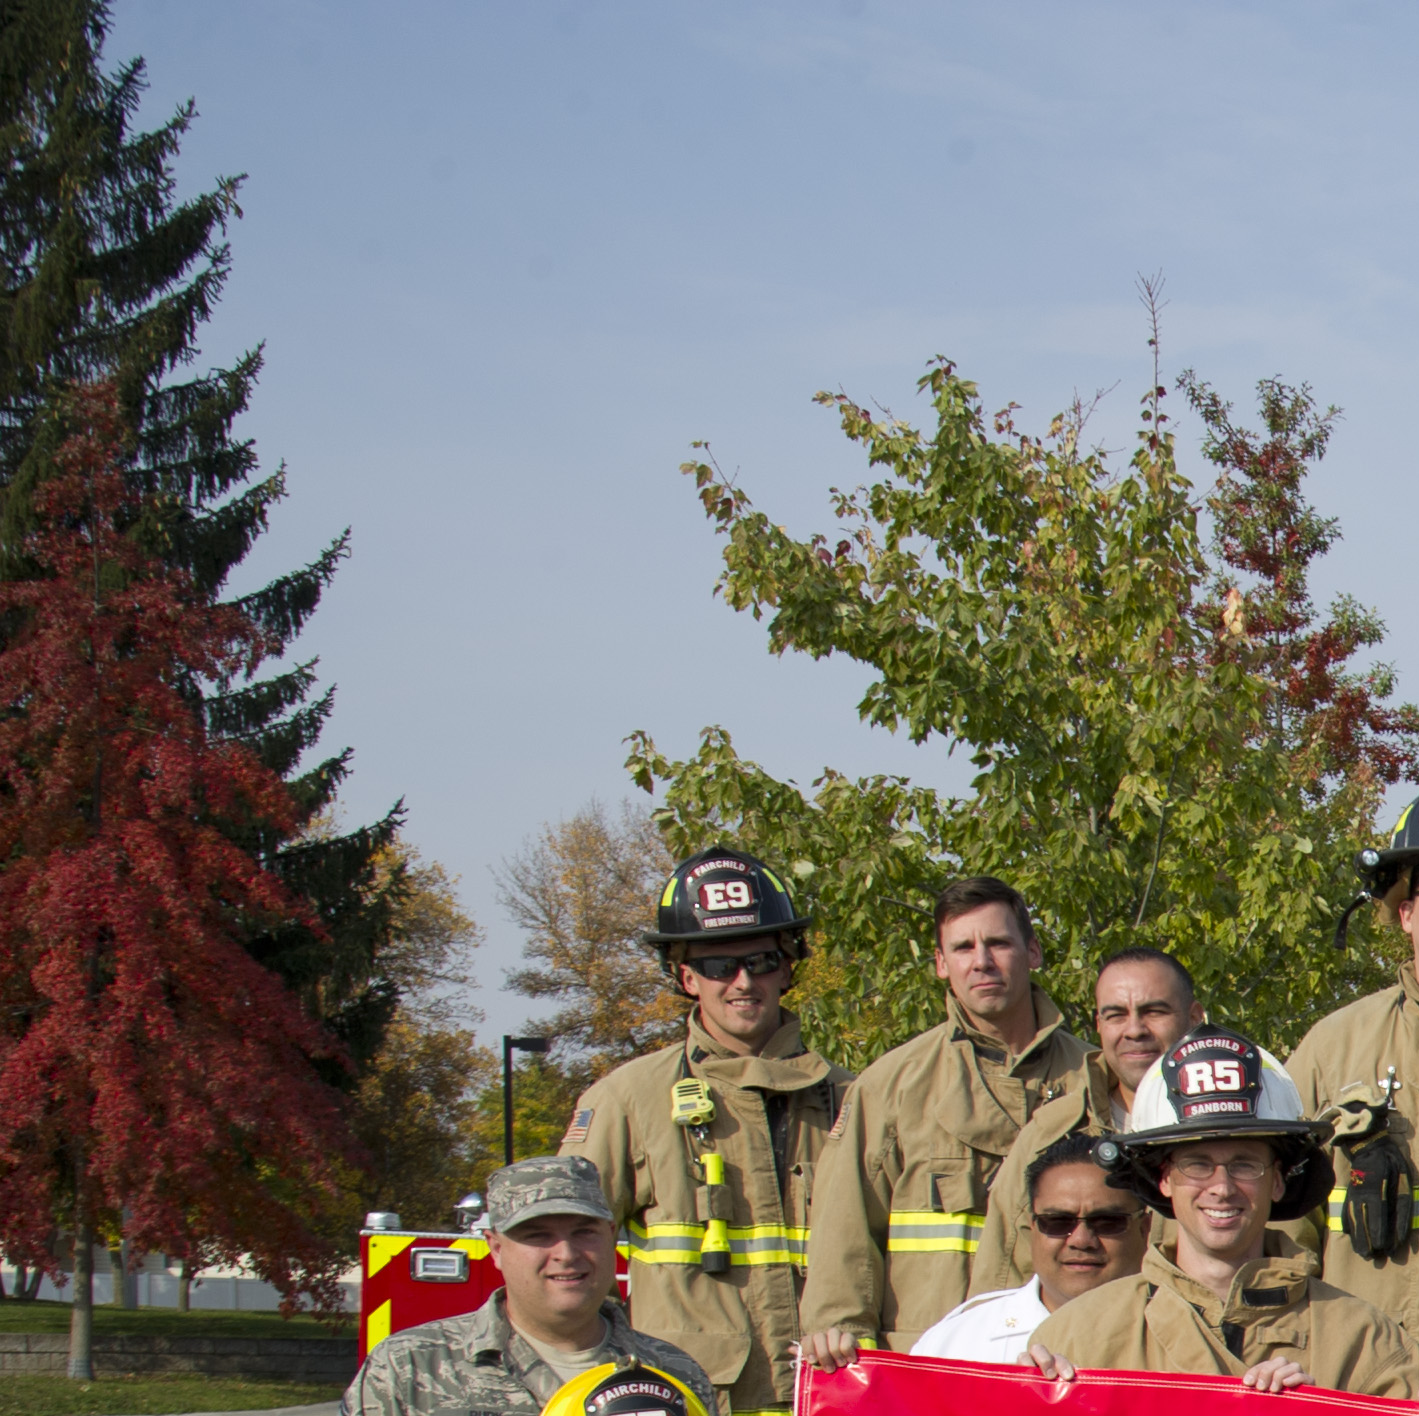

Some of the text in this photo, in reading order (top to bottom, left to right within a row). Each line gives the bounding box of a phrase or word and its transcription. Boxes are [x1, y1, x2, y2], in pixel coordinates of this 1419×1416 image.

[694, 860, 745, 877] FAIRCHILD
[703, 881, 750, 910] E9
[1180, 1039, 1239, 1057] FAIRCHILD
[1185, 1061, 1240, 1094] R5
[1191, 1102, 1243, 1115] SANBORN
[595, 1383, 671, 1406] FAIRCHILD
